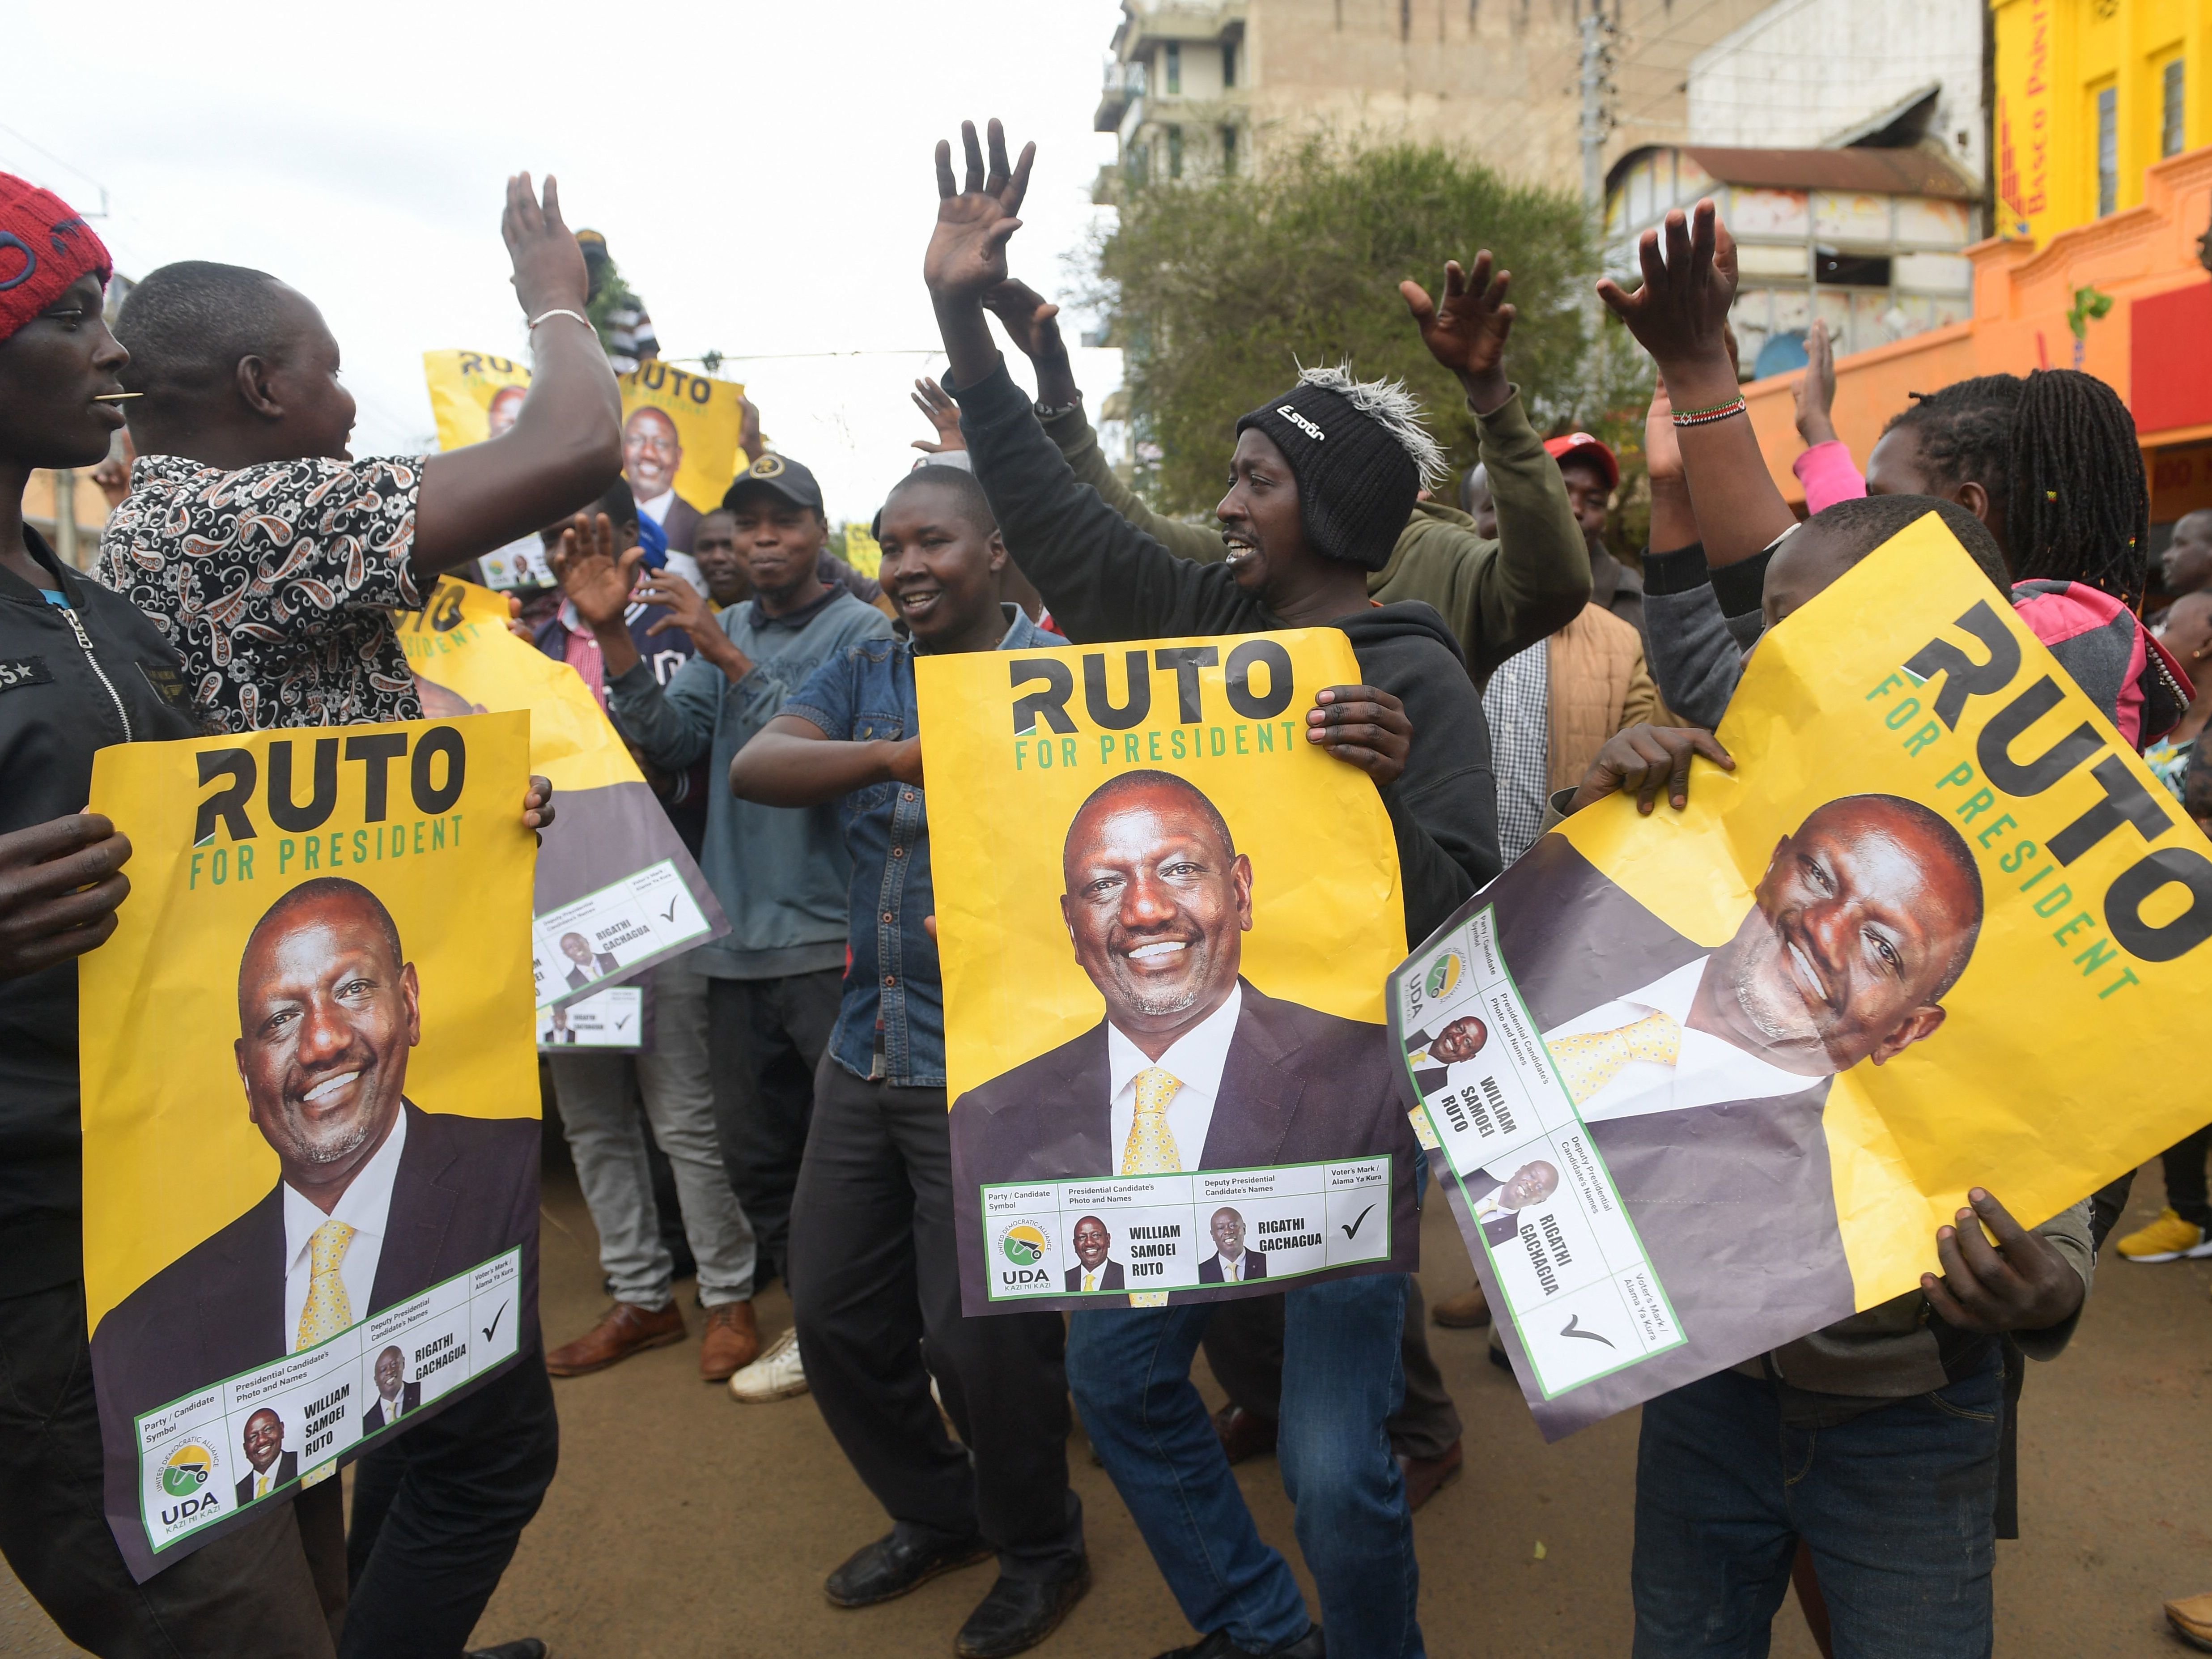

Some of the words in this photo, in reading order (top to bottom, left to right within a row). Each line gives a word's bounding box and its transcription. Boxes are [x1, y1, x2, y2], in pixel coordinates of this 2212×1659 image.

[1009, 639, 1294, 736] RUTO
[1015, 738, 1077, 770] FOR
[1100, 721, 1295, 764] PRESIDENT
[193, 726, 466, 848] RUTO
[1900, 599, 2212, 963] RUTO
[190, 845, 254, 890] FOR
[280, 815, 463, 874] PRESIDENT
[1866, 673, 1940, 757] FOR
[1935, 761, 2140, 1000] PRESIDENT
[596, 919, 631, 940] RIGATHI
[603, 925, 650, 952] GACHAGUA
[1483, 939, 1496, 975] Candidate
[1410, 973, 1423, 1019] UDA
[1490, 997, 1505, 1024] Photo
[1502, 1022, 1512, 1037] and
[1510, 1038, 1527, 1066] Names
[1500, 993, 1526, 1046] Presidential
[1524, 1042, 1549, 1085] Candidate's
[1441, 1095, 1469, 1133] RUTO
[1461, 1085, 1495, 1138] SAMOEI
[1480, 1076, 1517, 1135] WILLIAM
[1205, 1179, 1230, 1188] Deputy
[1232, 1175, 1275, 1185] Presidential
[1331, 1168, 1355, 1176] Voter's
[1357, 1166, 1375, 1174] Mark
[1332, 1177, 1354, 1186] Alama
[1561, 1141, 1586, 1187] Candidate's
[1582, 1187, 1598, 1214] Names
[1571, 1136, 1588, 1166] Deputy
[1585, 1166, 1613, 1212] Presidential
[988, 1192, 1008, 1201] Party
[1014, 1190, 1050, 1199] Candidate
[1069, 1186, 1112, 1195] Presidential
[1113, 1183, 1155, 1193] Candidate's
[1107, 1195, 1132, 1203] Names
[1205, 1187, 1246, 1196] Candidate's
[989, 1202, 1016, 1211] Symbol
[1002, 1219, 1039, 1236] DEMOCRATIC
[1038, 1225, 1052, 1251] ALLIANCE
[1129, 1225, 1180, 1240] WILLIAM
[1258, 1217, 1305, 1234] RIGATHI
[1259, 1233, 1322, 1252] GACHAGUA
[1539, 1213, 1573, 1267] RIGATHI
[1131, 1243, 1176, 1258] SAMOEI
[1520, 1223, 1560, 1296] GACHAGUA
[475, 1267, 494, 1281] Voter's
[495, 1260, 508, 1272] Mark
[475, 1277, 492, 1290] Alama
[493, 1274, 500, 1282] Ya
[501, 1267, 514, 1278] Kura
[1003, 1269, 1049, 1285] UDA
[1132, 1262, 1163, 1276] RUTO
[371, 1316, 392, 1332] Deputy
[394, 1298, 429, 1323] Presidential
[1624, 1278, 1640, 1307] Alama
[1635, 1306, 1646, 1318] Ya
[1643, 1319, 1656, 1341] Kura
[1635, 1273, 1653, 1303] Voter's
[1649, 1304, 1665, 1327] Mark
[371, 1321, 406, 1341] Candidate's
[408, 1310, 428, 1326] Names
[415, 1332, 454, 1363] RIGATHI
[416, 1344, 466, 1381] GACHAGUA
[236, 1368, 284, 1392] Presidential
[287, 1351, 329, 1373] Candidate's
[236, 1388, 260, 1403] Photo
[263, 1382, 277, 1393] and
[279, 1372, 307, 1387] Names
[144, 1417, 167, 1433] Party
[174, 1395, 215, 1419] Candidate
[304, 1383, 350, 1420] WILLIAM
[145, 1423, 177, 1444] Symbol
[305, 1404, 345, 1438] SAMOEI
[305, 1430, 333, 1457] RUTO
[156, 1468, 164, 1492] UNITED
[161, 1436, 202, 1466] DEMOCRATIC
[201, 1439, 219, 1468] ALLIANCE
[161, 1491, 219, 1526] UDA
[165, 1519, 187, 1534] KAZI
[188, 1515, 197, 1523] NI
[200, 1505, 221, 1519] KAZI
